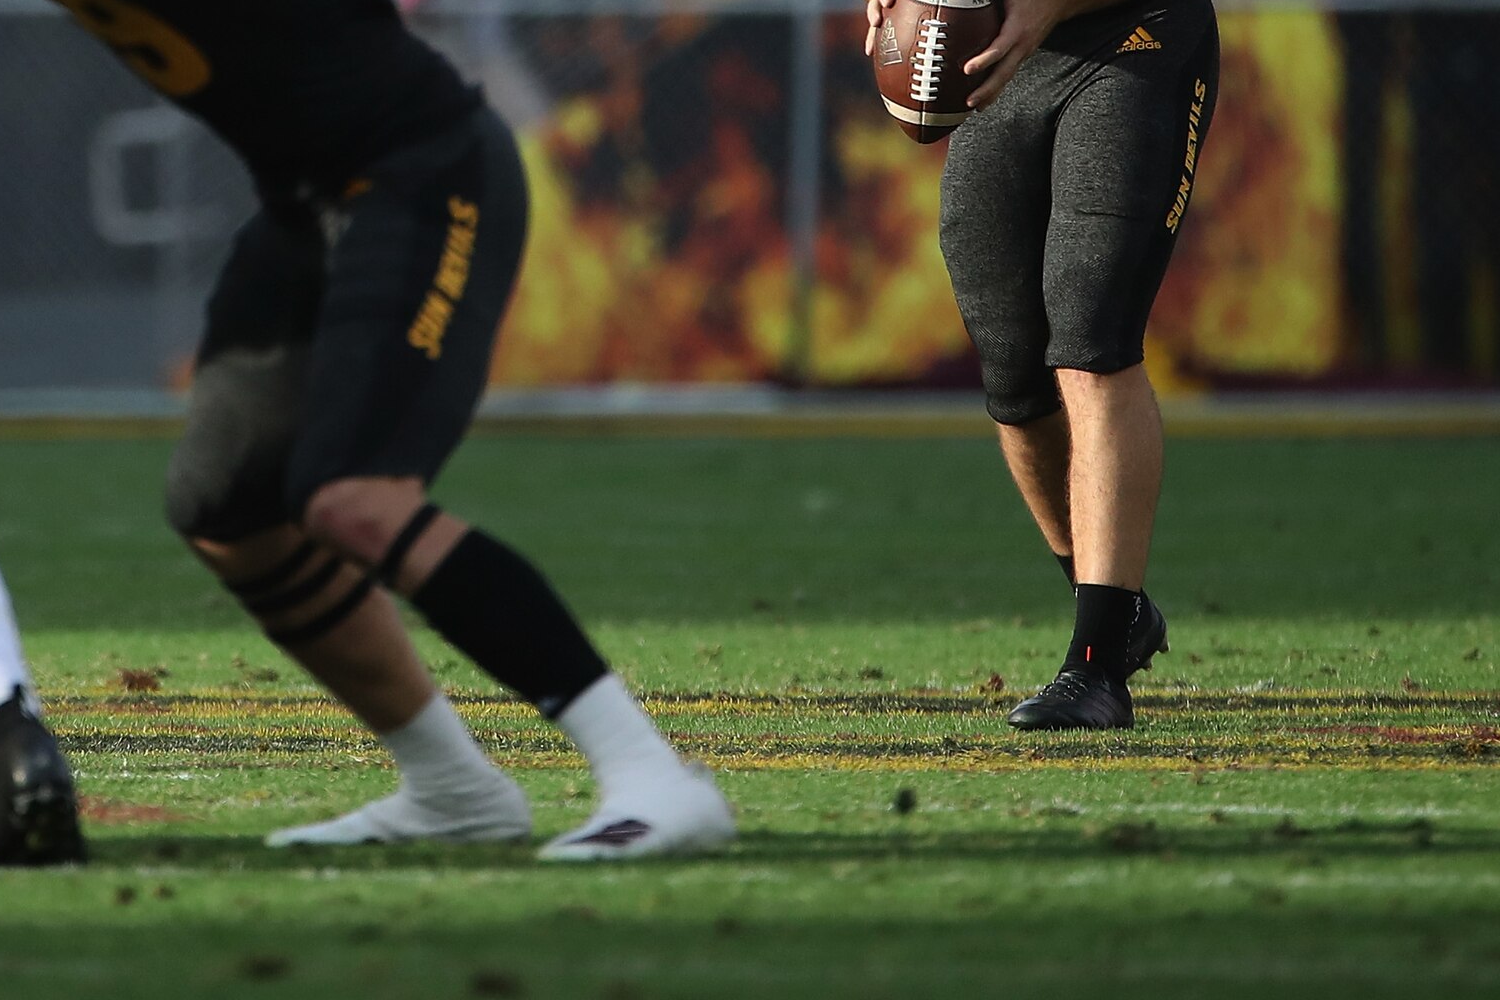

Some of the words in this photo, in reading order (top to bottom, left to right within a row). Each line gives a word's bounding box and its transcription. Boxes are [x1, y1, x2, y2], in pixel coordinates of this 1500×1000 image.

[1165, 174, 1192, 234] SUN
[1184, 78, 1206, 174] DEVILS
[407, 288, 453, 360] SUN
